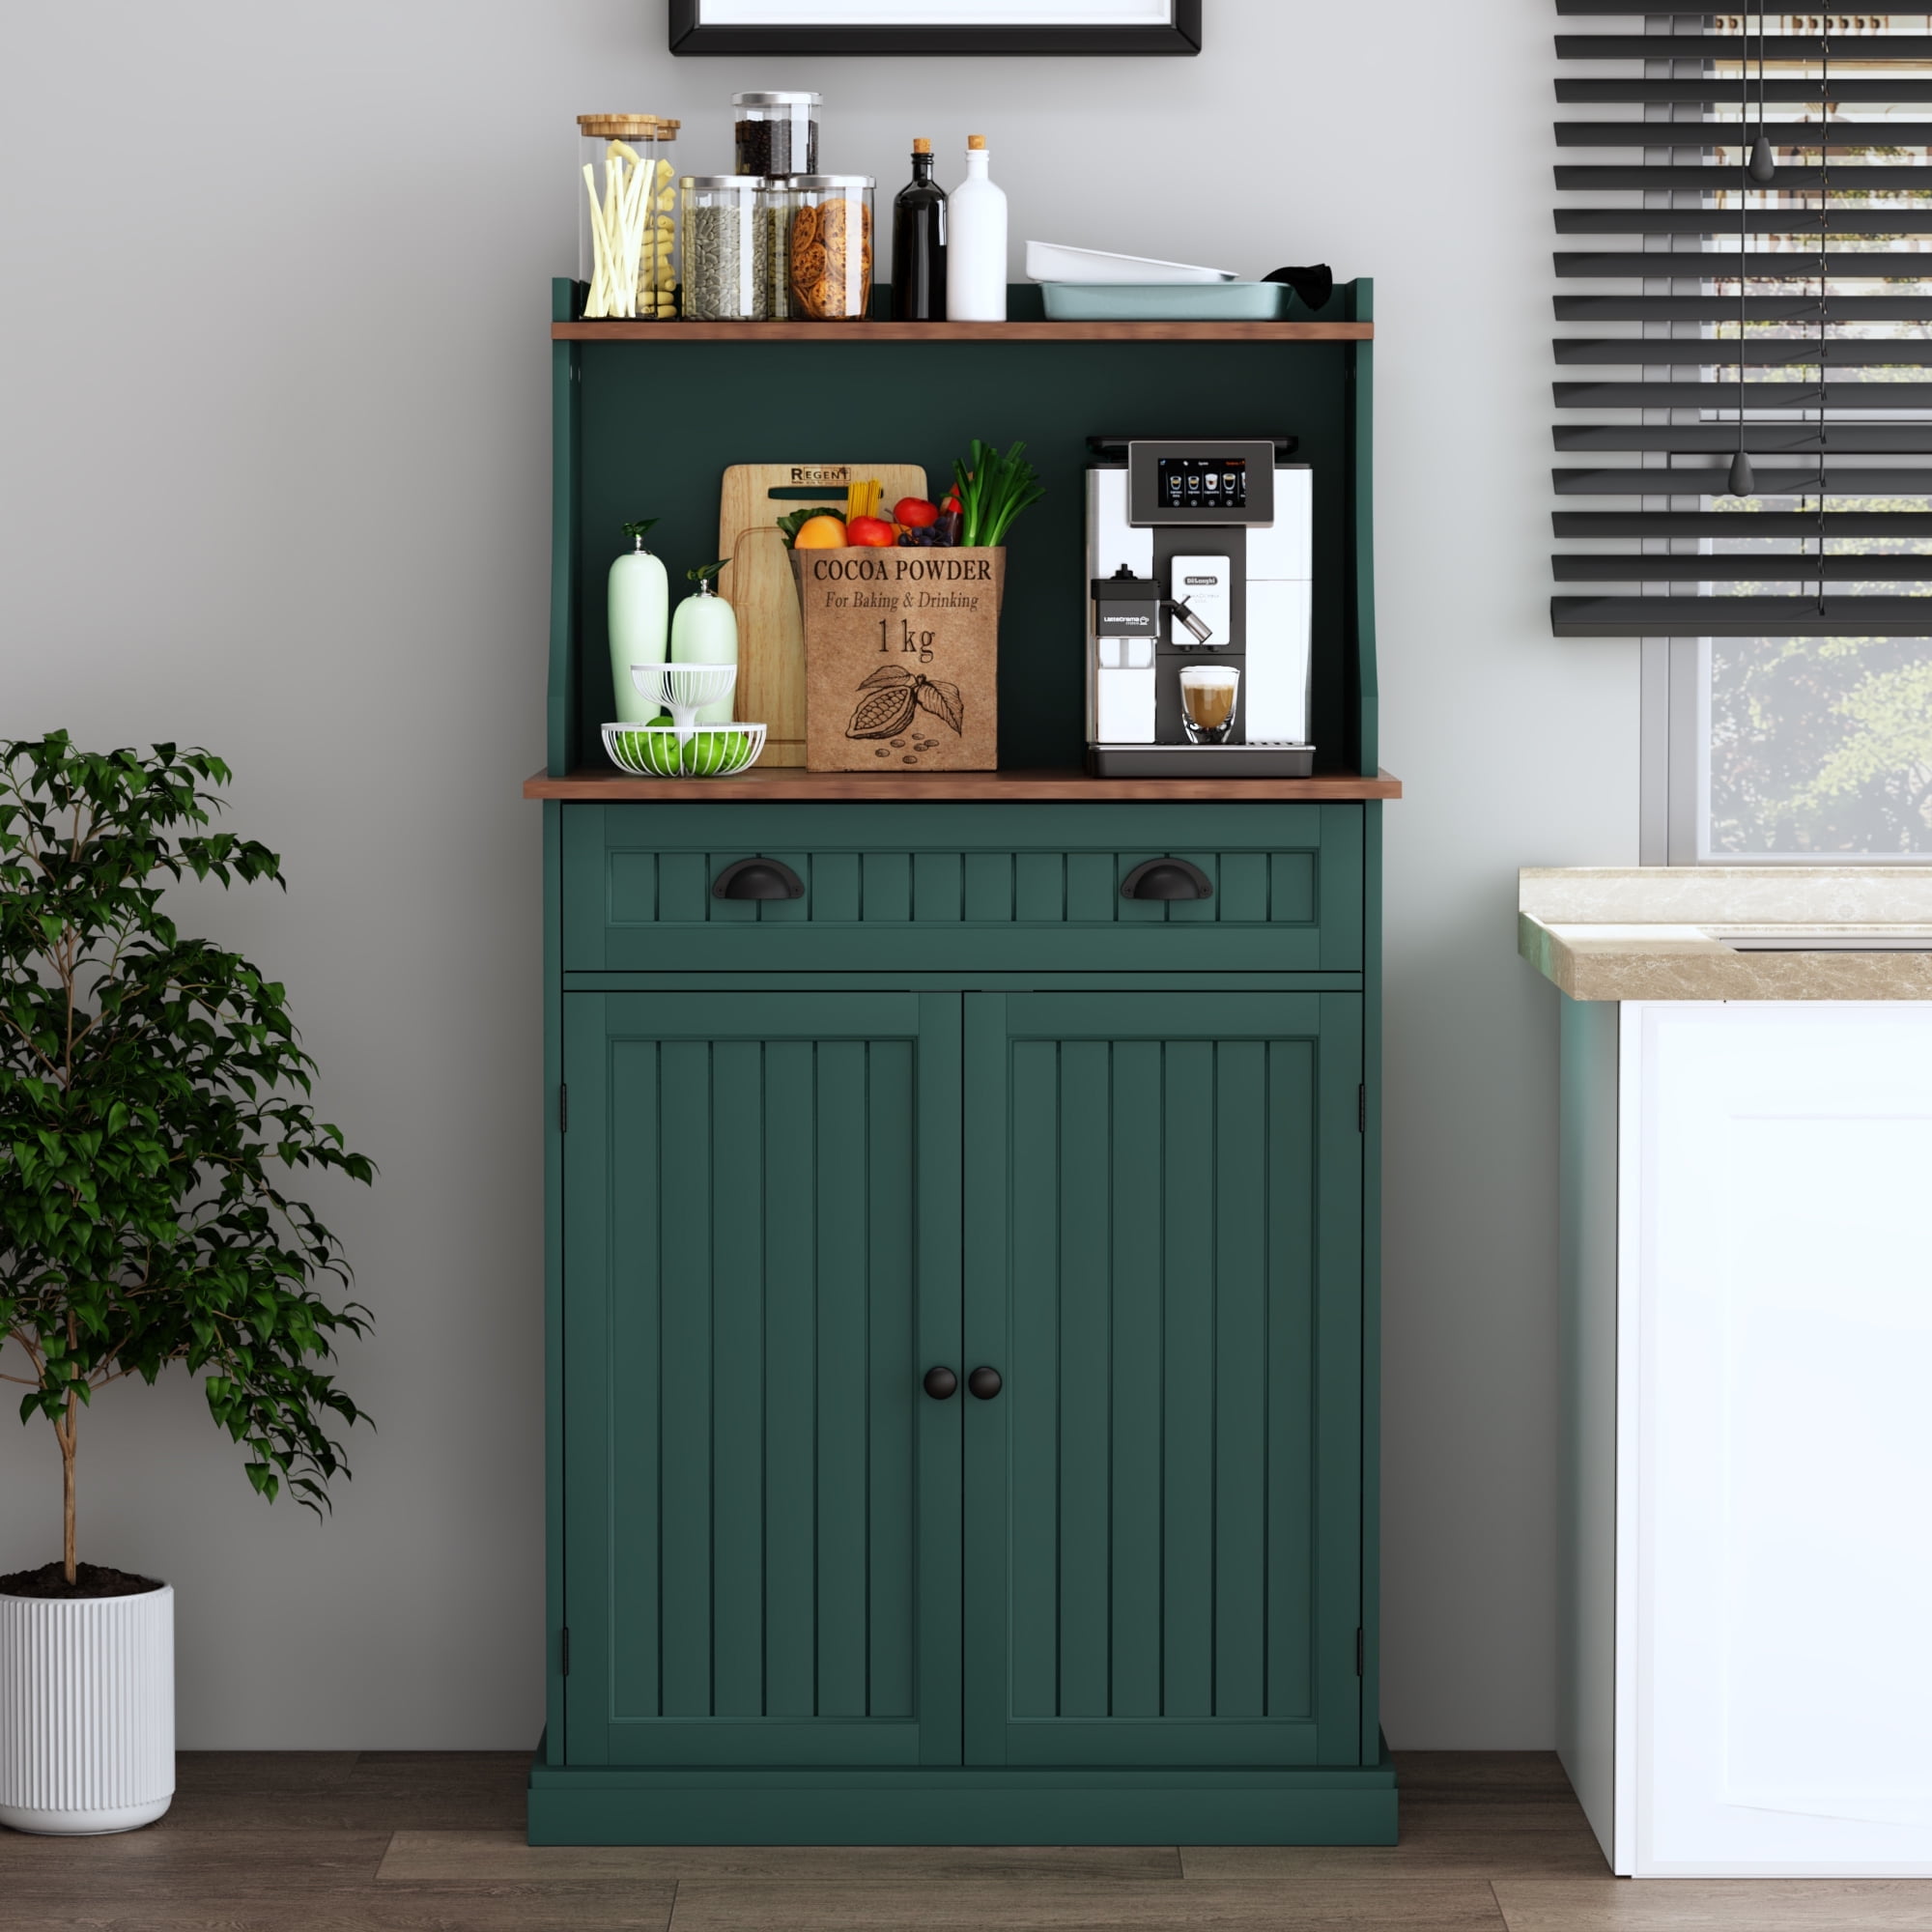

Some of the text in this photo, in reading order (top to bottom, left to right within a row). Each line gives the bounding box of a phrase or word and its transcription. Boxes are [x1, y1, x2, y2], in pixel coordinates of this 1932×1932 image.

[813, 559, 889, 581] COCOA
[896, 559, 992, 581] POWDER
[826, 591, 979, 612] For Baking & Drinking
[878, 618, 936, 663] 1 kg
